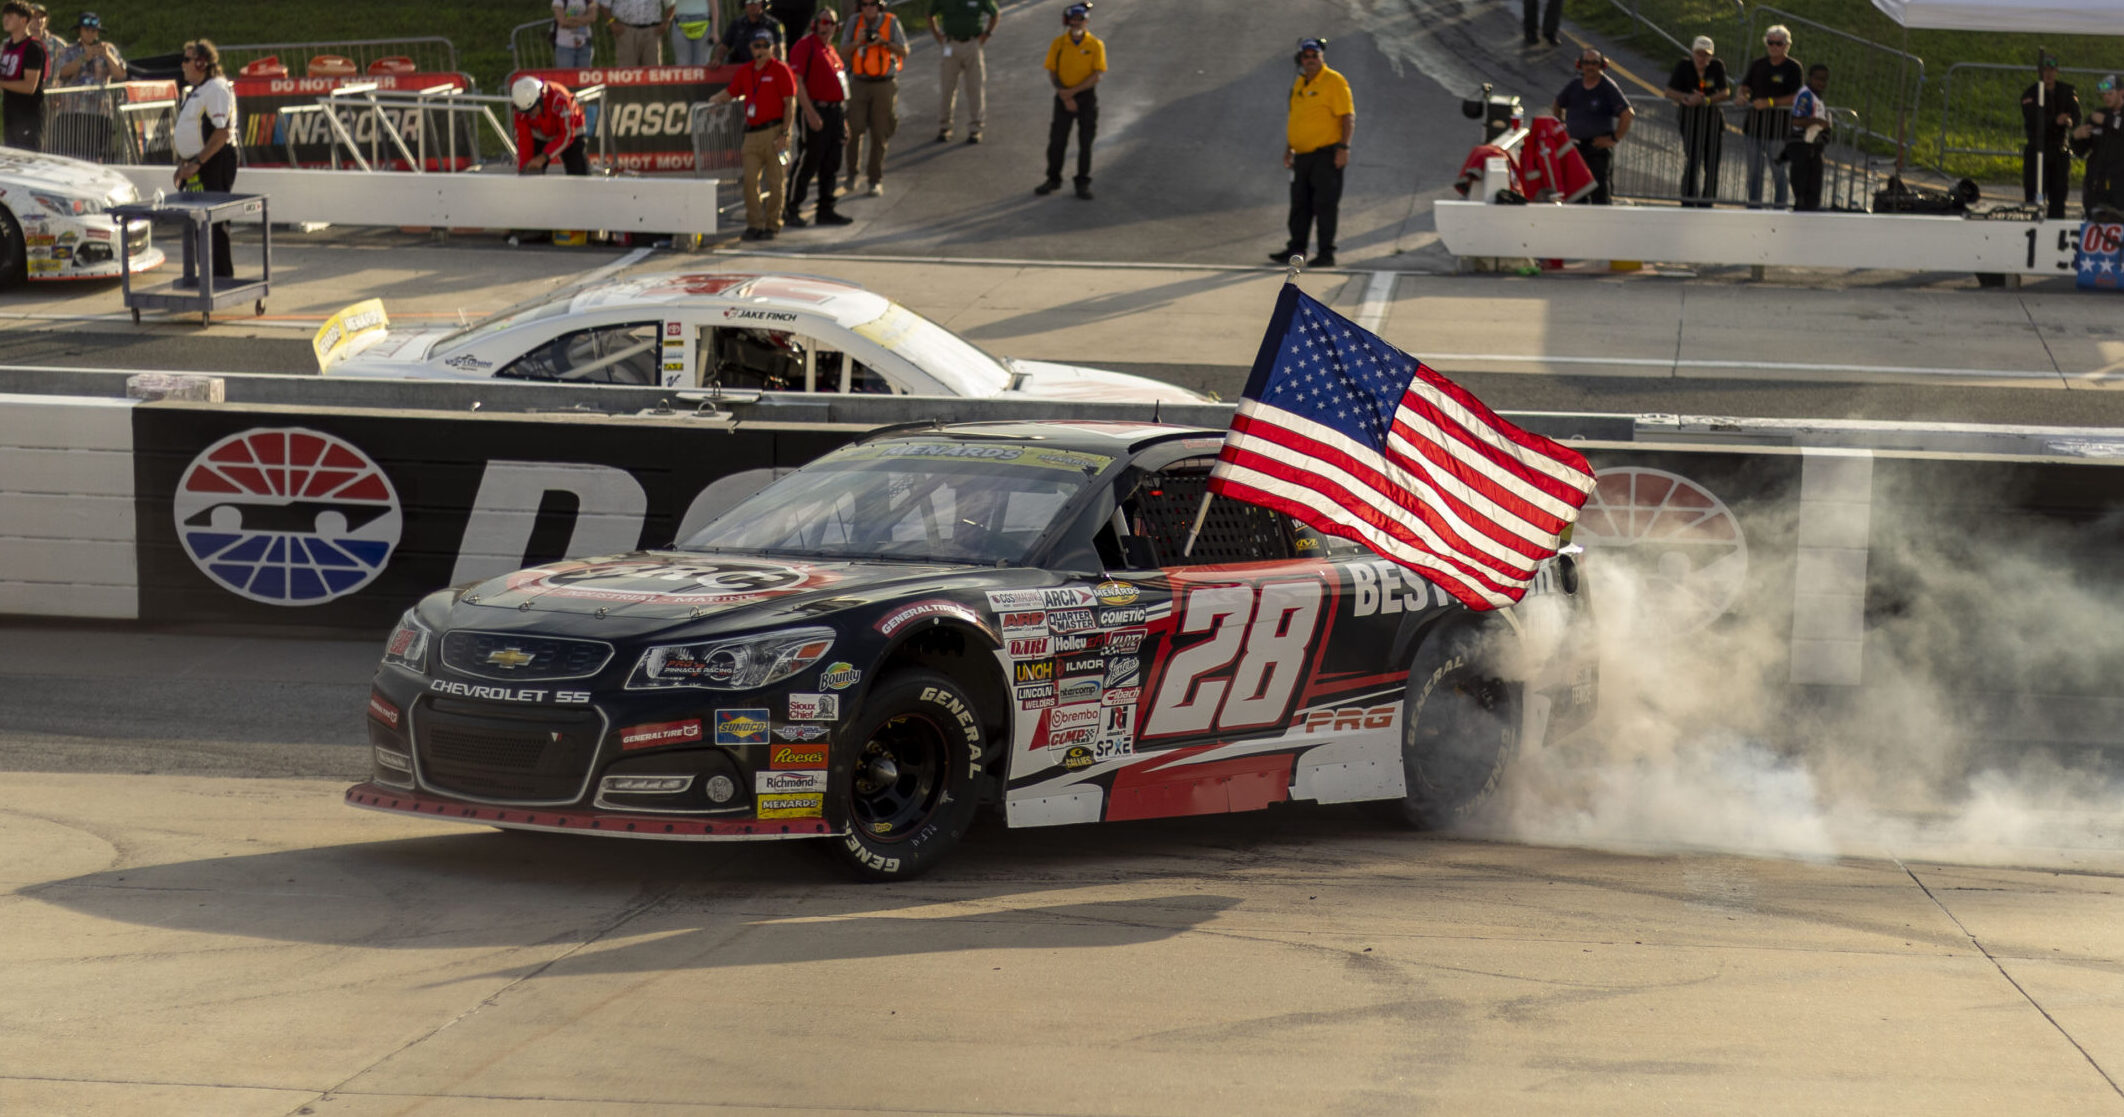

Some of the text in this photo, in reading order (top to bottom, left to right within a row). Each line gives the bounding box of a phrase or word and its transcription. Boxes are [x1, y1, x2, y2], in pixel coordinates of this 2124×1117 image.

[579, 68, 705, 84] DO NOT ENTER
[271, 79, 294, 92] DO
[299, 78, 334, 91] NOT
[289, 110, 421, 145] NASCAR
[618, 155, 653, 170] NOT
[657, 154, 703, 168] MOV
[2083, 223, 2122, 254] 06
[738, 310, 797, 322] JAKE FINCH
[883, 444, 1023, 460] MENARDS
[1044, 589, 1079, 607] ARCA
[1094, 586, 1140, 598] MENARDS
[881, 604, 931, 636] GENERAL
[1003, 612, 1045, 627] ARP
[1048, 610, 1090, 626] QUARTER
[1058, 619, 1094, 631] MASTER
[1101, 609, 1146, 625] COMETIC
[1066, 659, 1104, 672] ILMOR
[1144, 580, 1323, 740] 28
[1017, 661, 1053, 681] UNOH
[819, 669, 861, 692] Bounty
[430, 679, 592, 704] CHEVROLET SS
[1018, 686, 1053, 699] LINCOLN
[1060, 686, 1096, 698] ntercomp
[790, 701, 816, 710] Sioux
[1025, 698, 1055, 709] WELDERS
[789, 710, 814, 719] Chief
[1061, 708, 1098, 723] brembo
[1305, 707, 1396, 734] PRG
[720, 722, 766, 733] SUNOCO
[920, 687, 982, 780] GENERAL
[623, 728, 683, 744] GENERAL TIRE
[1051, 728, 1086, 746] COMP
[774, 747, 824, 763] Reese's
[766, 776, 814, 788] Richmond
[763, 799, 818, 810] MENARDS
